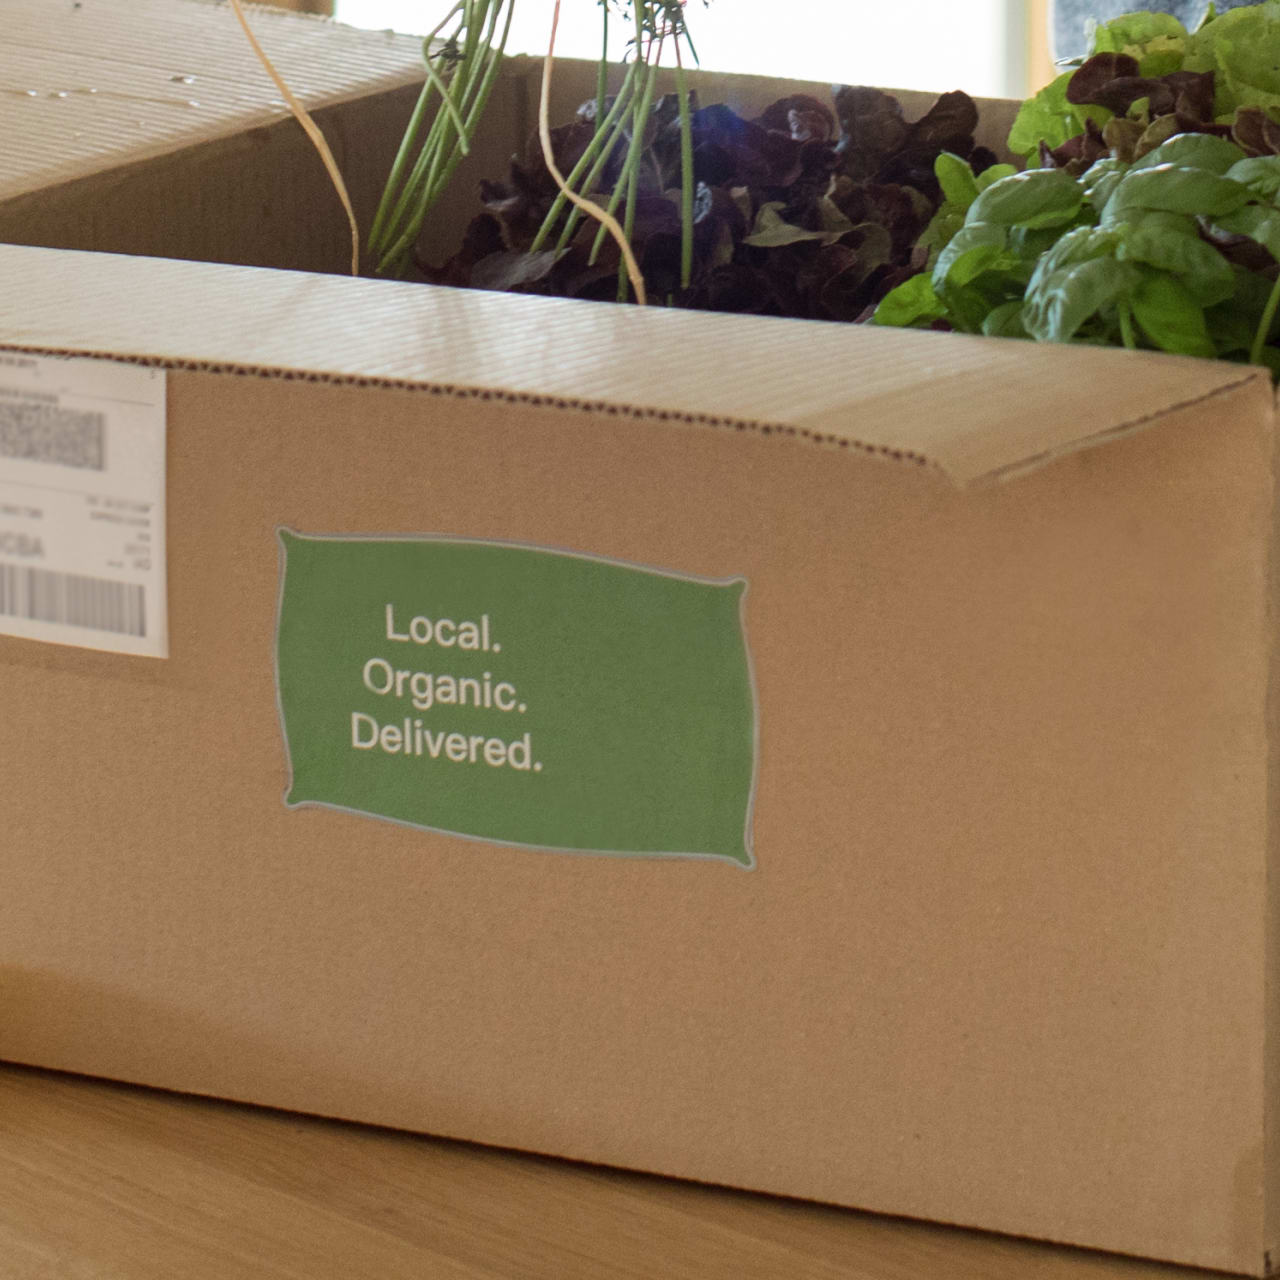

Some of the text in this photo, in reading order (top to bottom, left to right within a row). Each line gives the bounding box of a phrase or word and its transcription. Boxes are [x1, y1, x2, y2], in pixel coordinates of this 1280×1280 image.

[386, 604, 502, 652] Local.
[363, 657, 528, 713] Organic.
[351, 711, 543, 771] Delivered.
